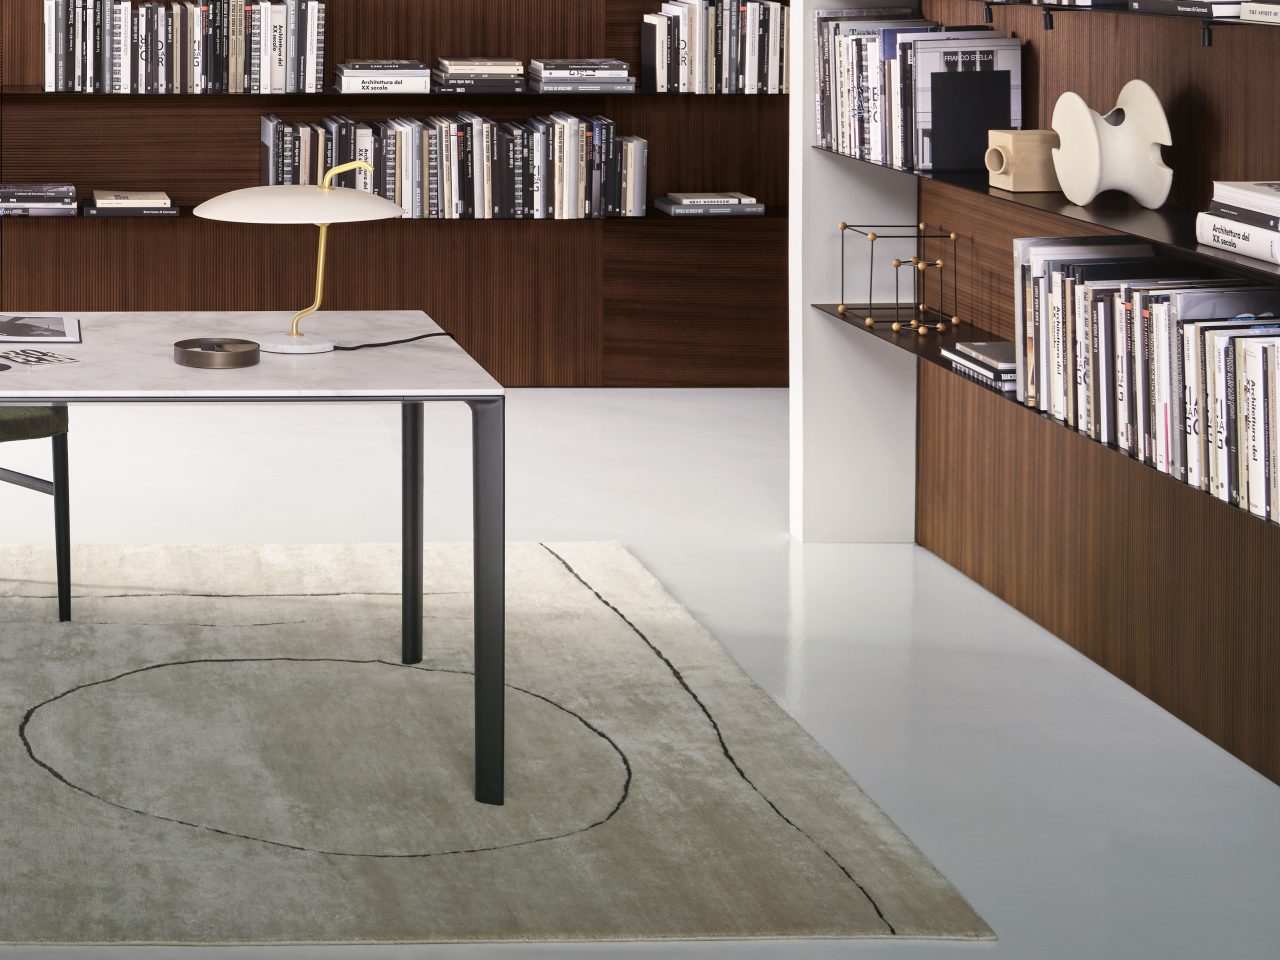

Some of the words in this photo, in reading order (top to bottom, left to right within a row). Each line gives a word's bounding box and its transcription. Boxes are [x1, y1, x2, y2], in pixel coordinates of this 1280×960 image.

[1212, 224, 1240, 240] Architettura
[1242, 232, 1250, 242] del
[1212, 234, 1220, 244] XX
[1220, 238, 1237, 248] secolo
